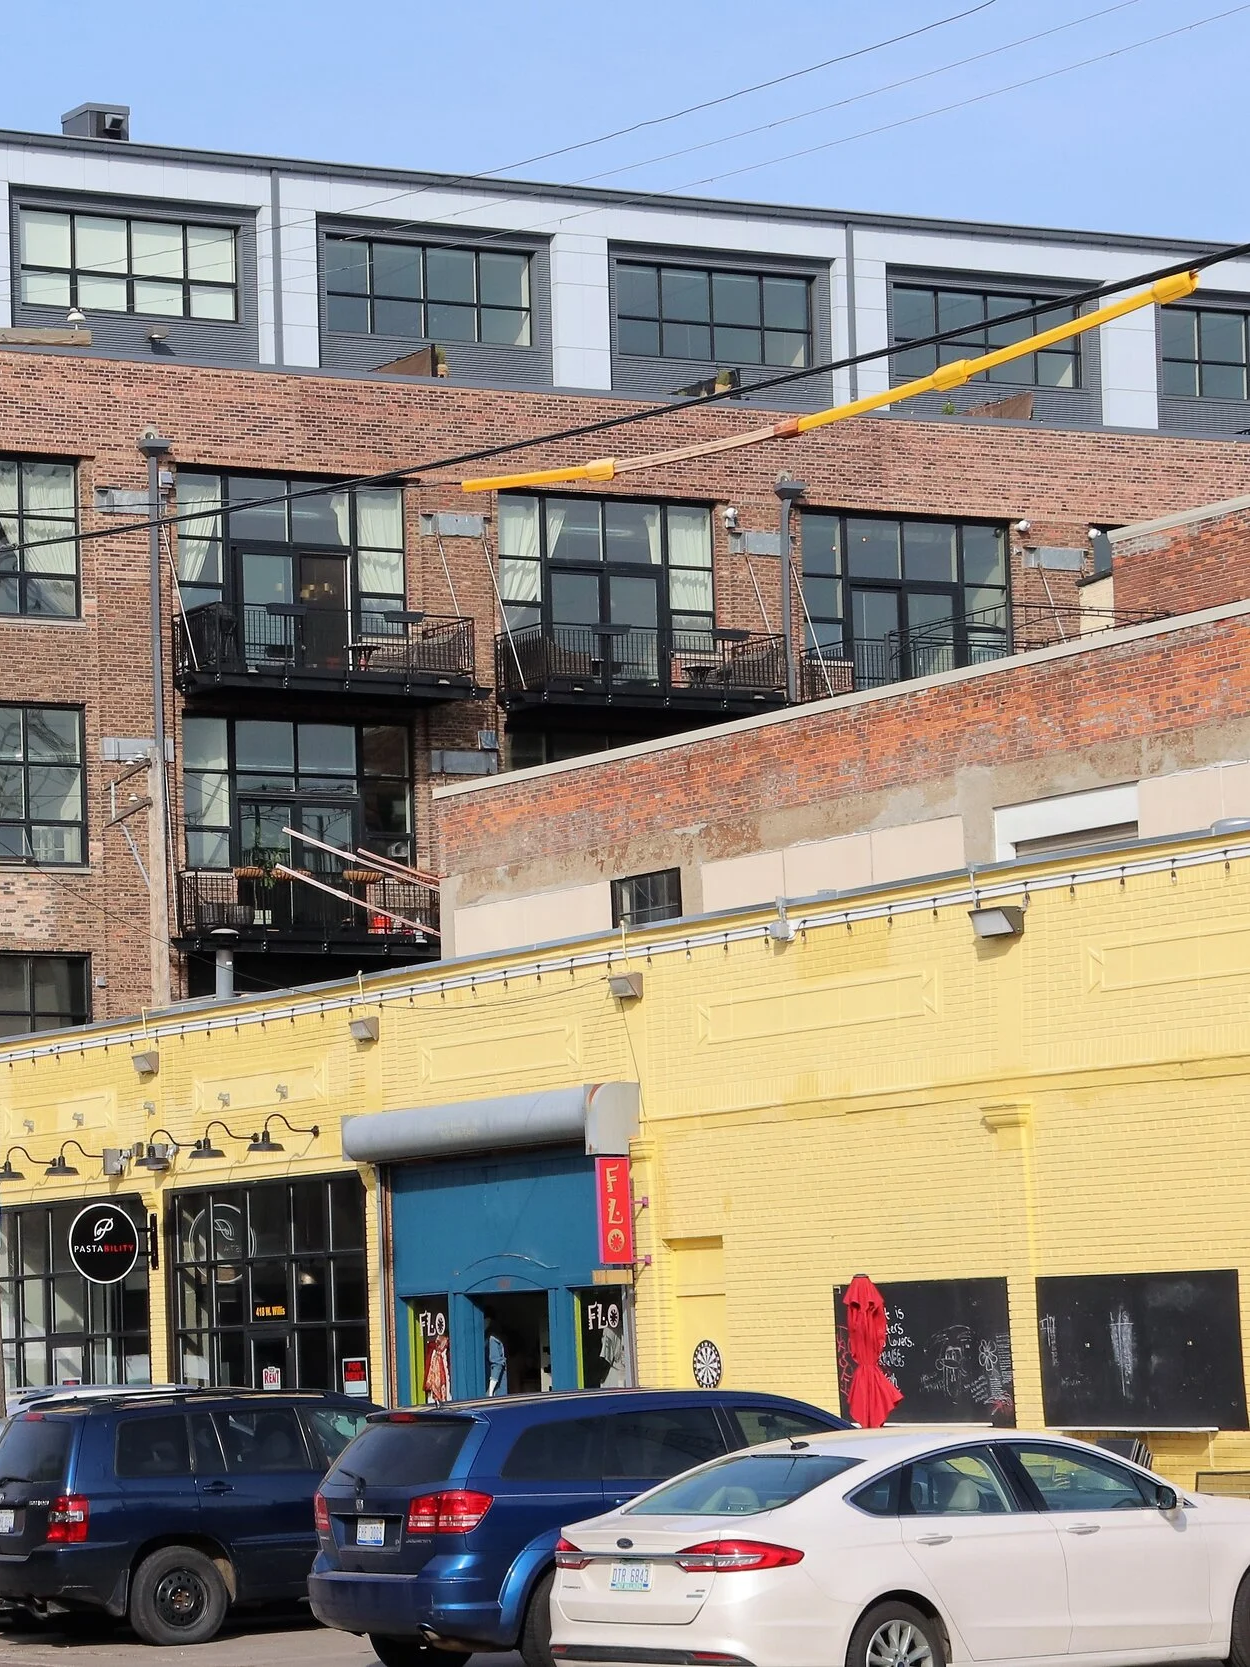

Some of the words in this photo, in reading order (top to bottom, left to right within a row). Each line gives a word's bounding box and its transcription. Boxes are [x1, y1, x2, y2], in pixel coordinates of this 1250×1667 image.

[606, 1163, 626, 1253] FLO
[74, 1244, 134, 1253] PASTABILITY
[419, 1310, 446, 1336] FLO
[588, 1301, 619, 1330] FLO
[264, 1369, 280, 1384] RENT
[630, 1568, 649, 1583] 6843
